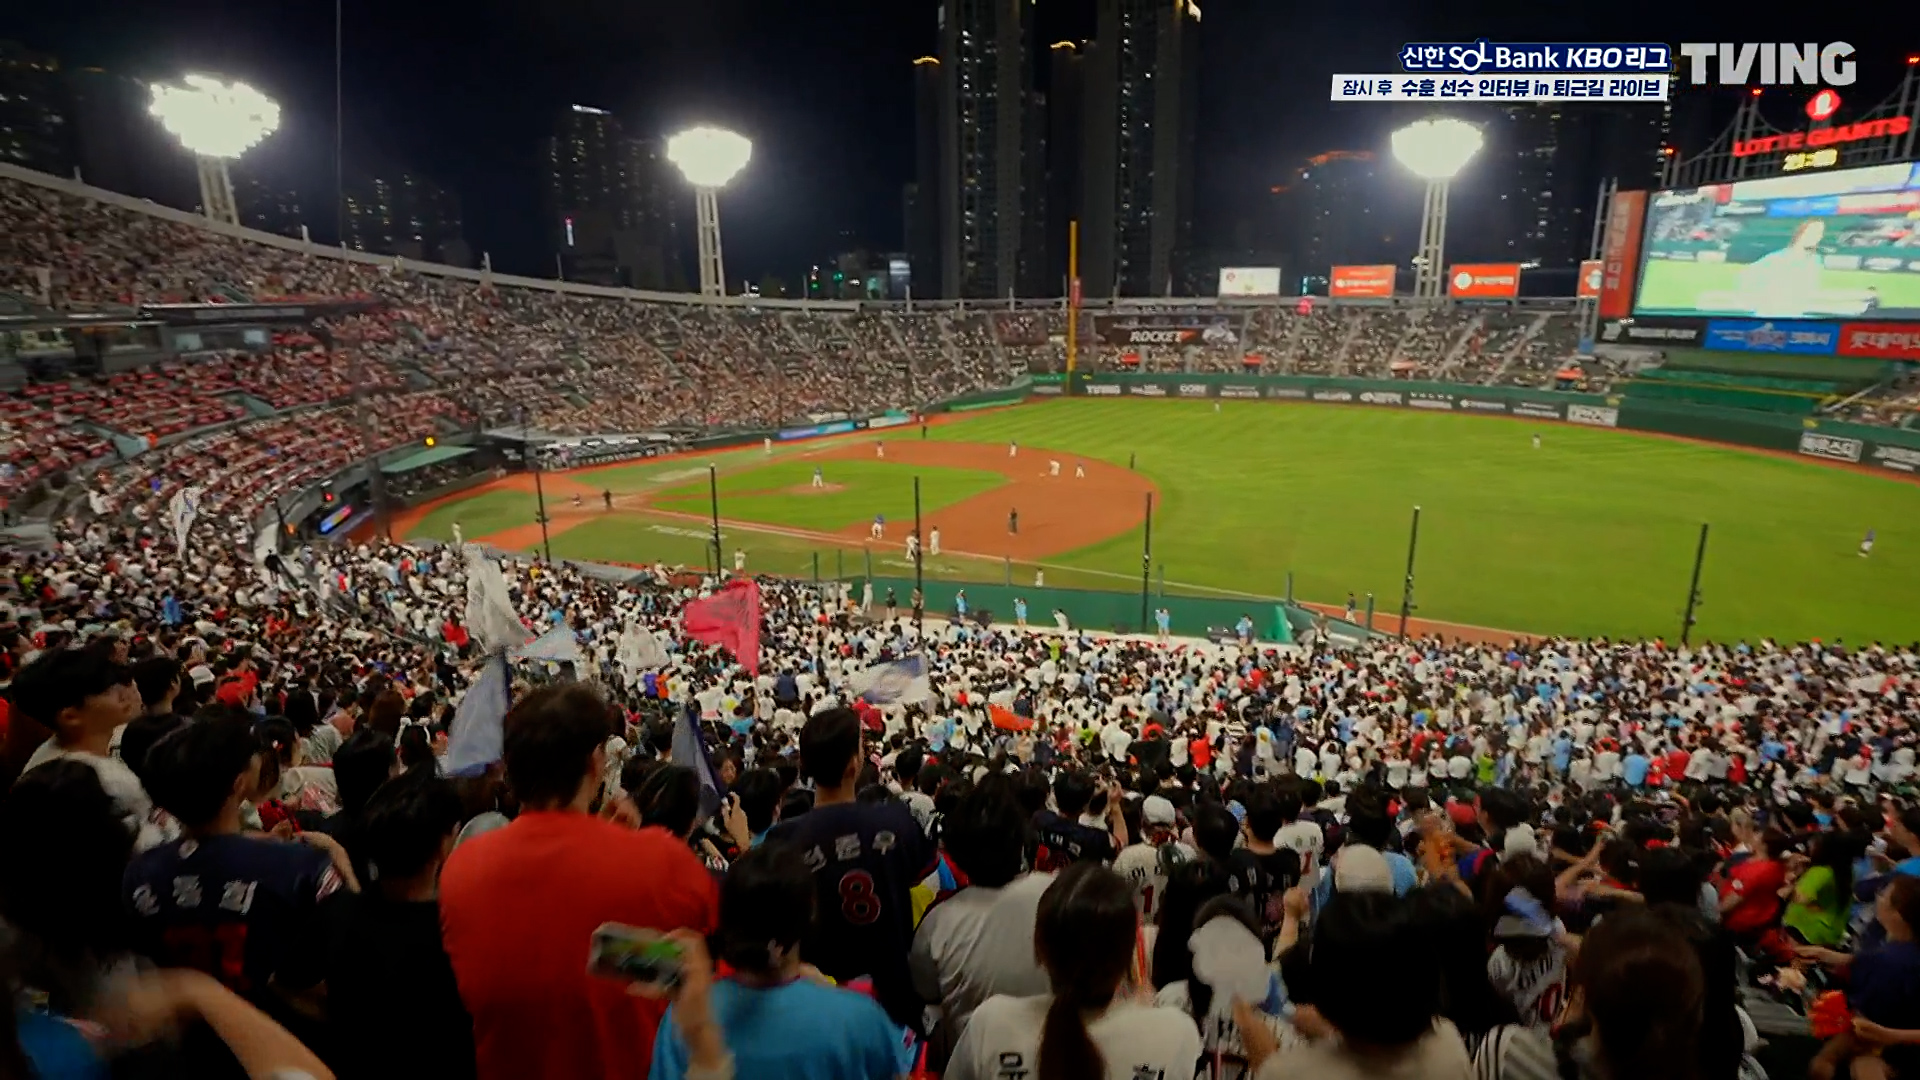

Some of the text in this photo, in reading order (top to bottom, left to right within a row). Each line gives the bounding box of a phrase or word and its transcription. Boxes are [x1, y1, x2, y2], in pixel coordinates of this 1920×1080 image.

[1733, 115, 1912, 157] LOTTE GIANTS
[839, 869, 881, 925] 8
